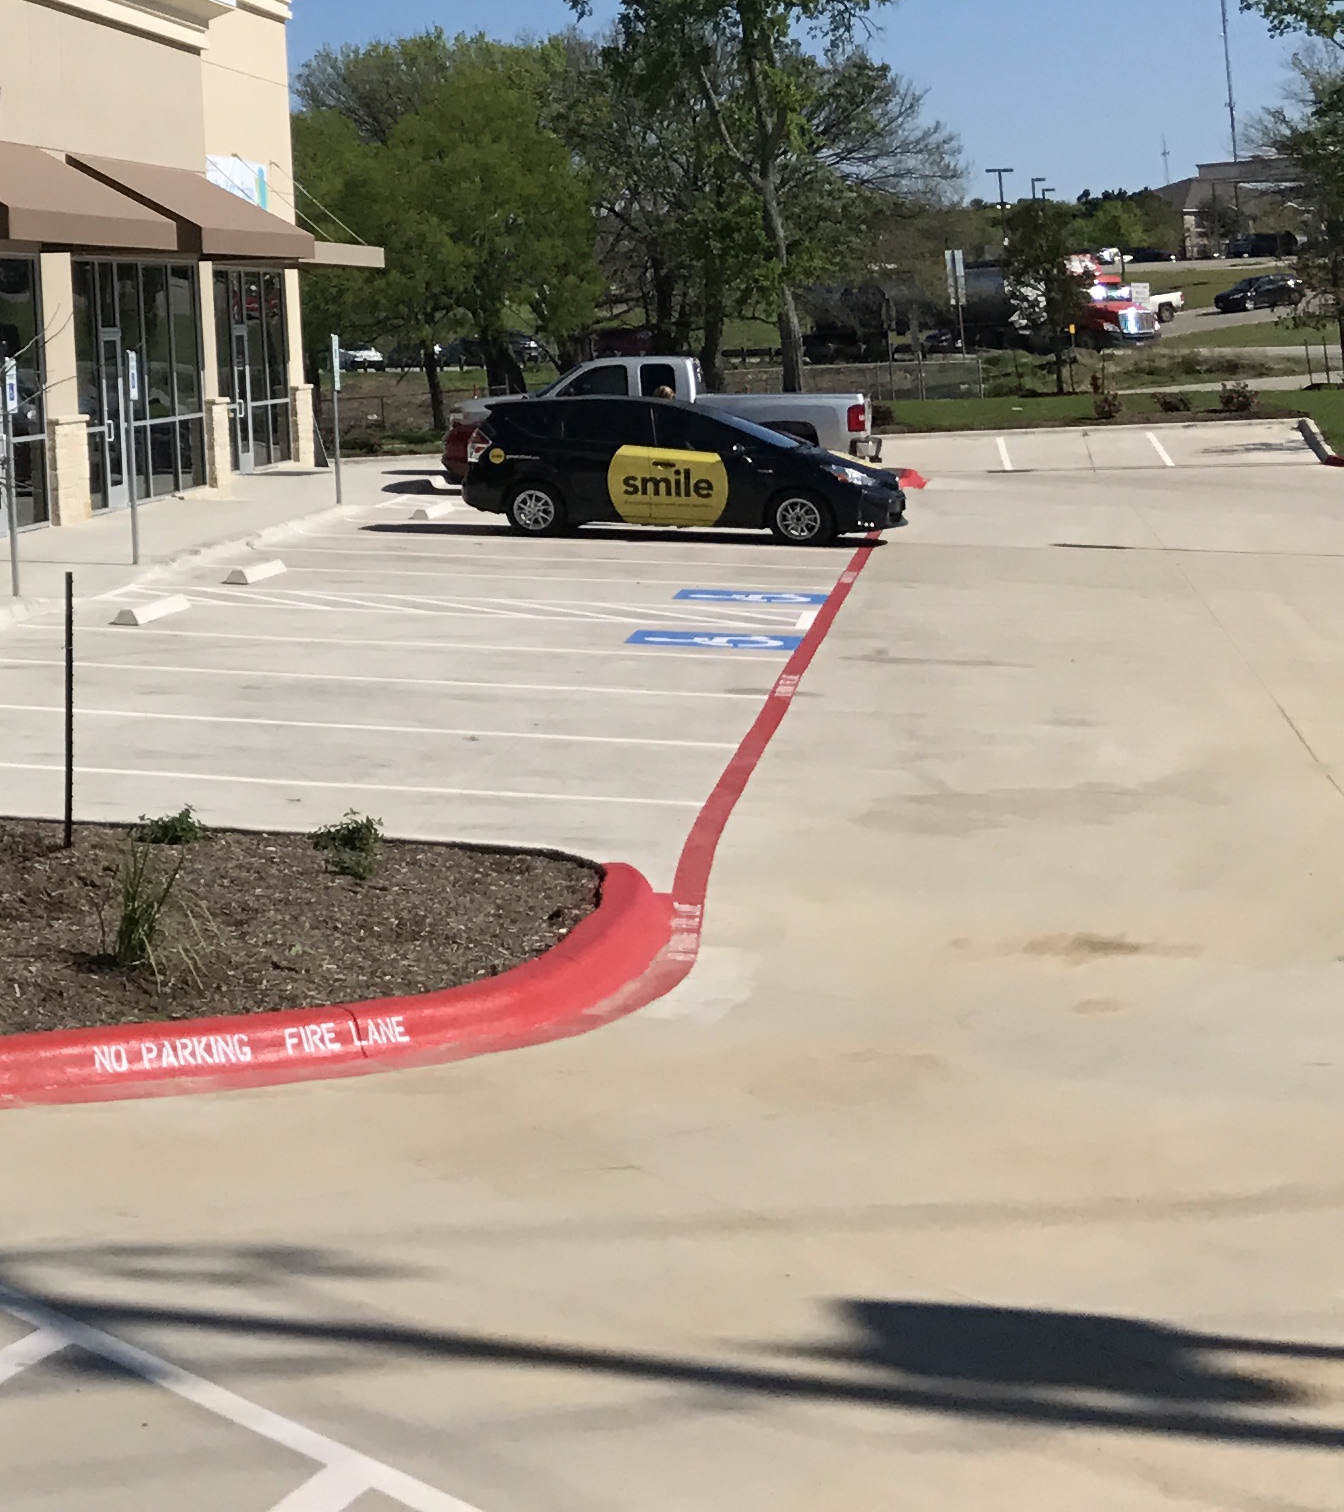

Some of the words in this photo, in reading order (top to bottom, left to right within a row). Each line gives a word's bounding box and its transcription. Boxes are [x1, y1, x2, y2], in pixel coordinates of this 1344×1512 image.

[622, 468, 715, 499] smile
[93, 1044, 129, 1074] NO
[141, 1033, 252, 1069] PARKING
[284, 1021, 341, 1057] FIRE
[348, 1016, 410, 1048] LANE
